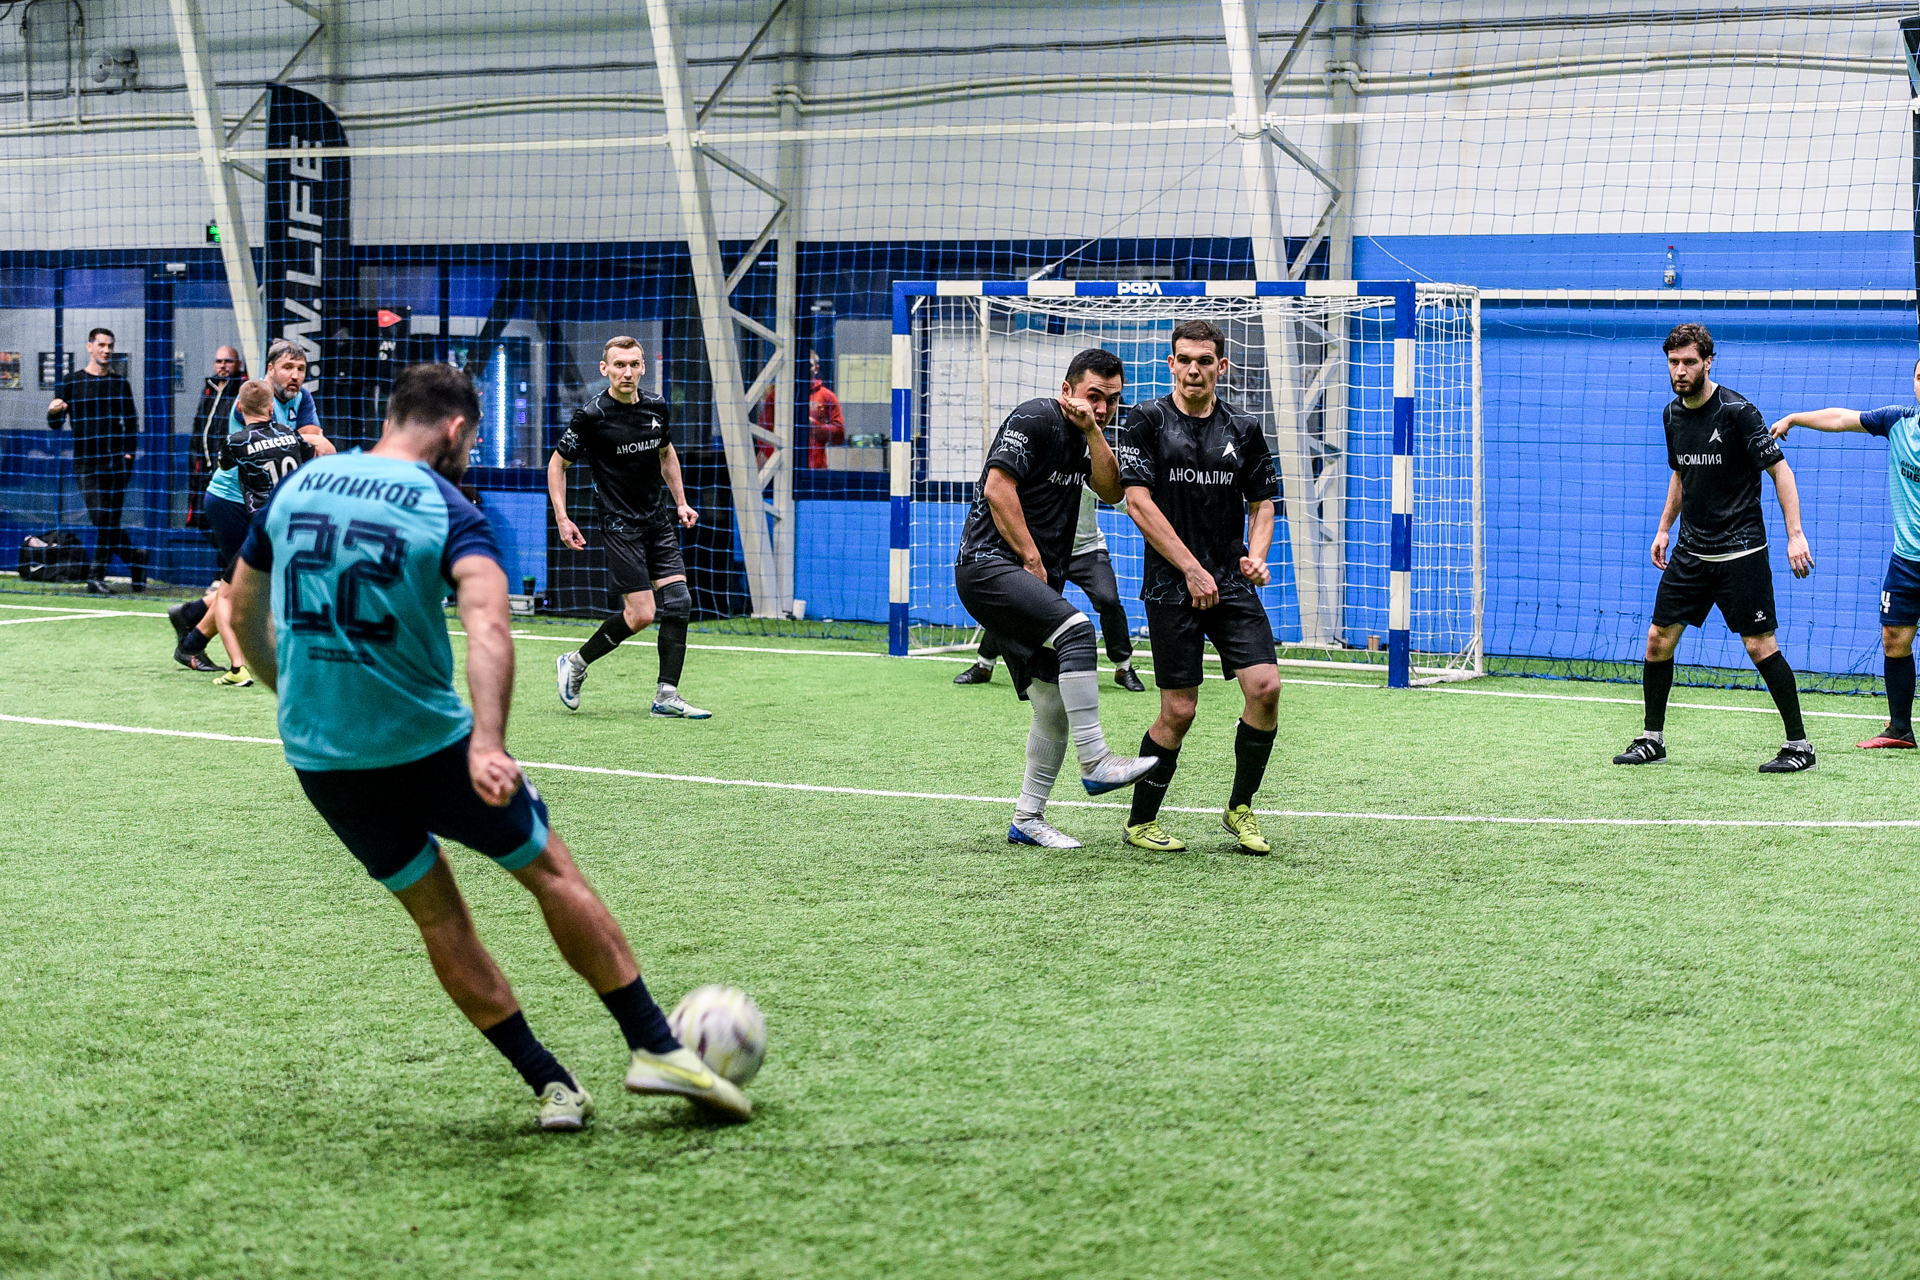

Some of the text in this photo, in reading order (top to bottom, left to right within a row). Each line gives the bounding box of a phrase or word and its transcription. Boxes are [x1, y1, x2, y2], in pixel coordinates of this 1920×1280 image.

[1005, 429, 1029, 444] CARGO
[299, 472, 422, 508] КУЛИКОВ
[1169, 467, 1234, 486] АНОМАЛИЯ
[284, 512, 409, 647] 22
